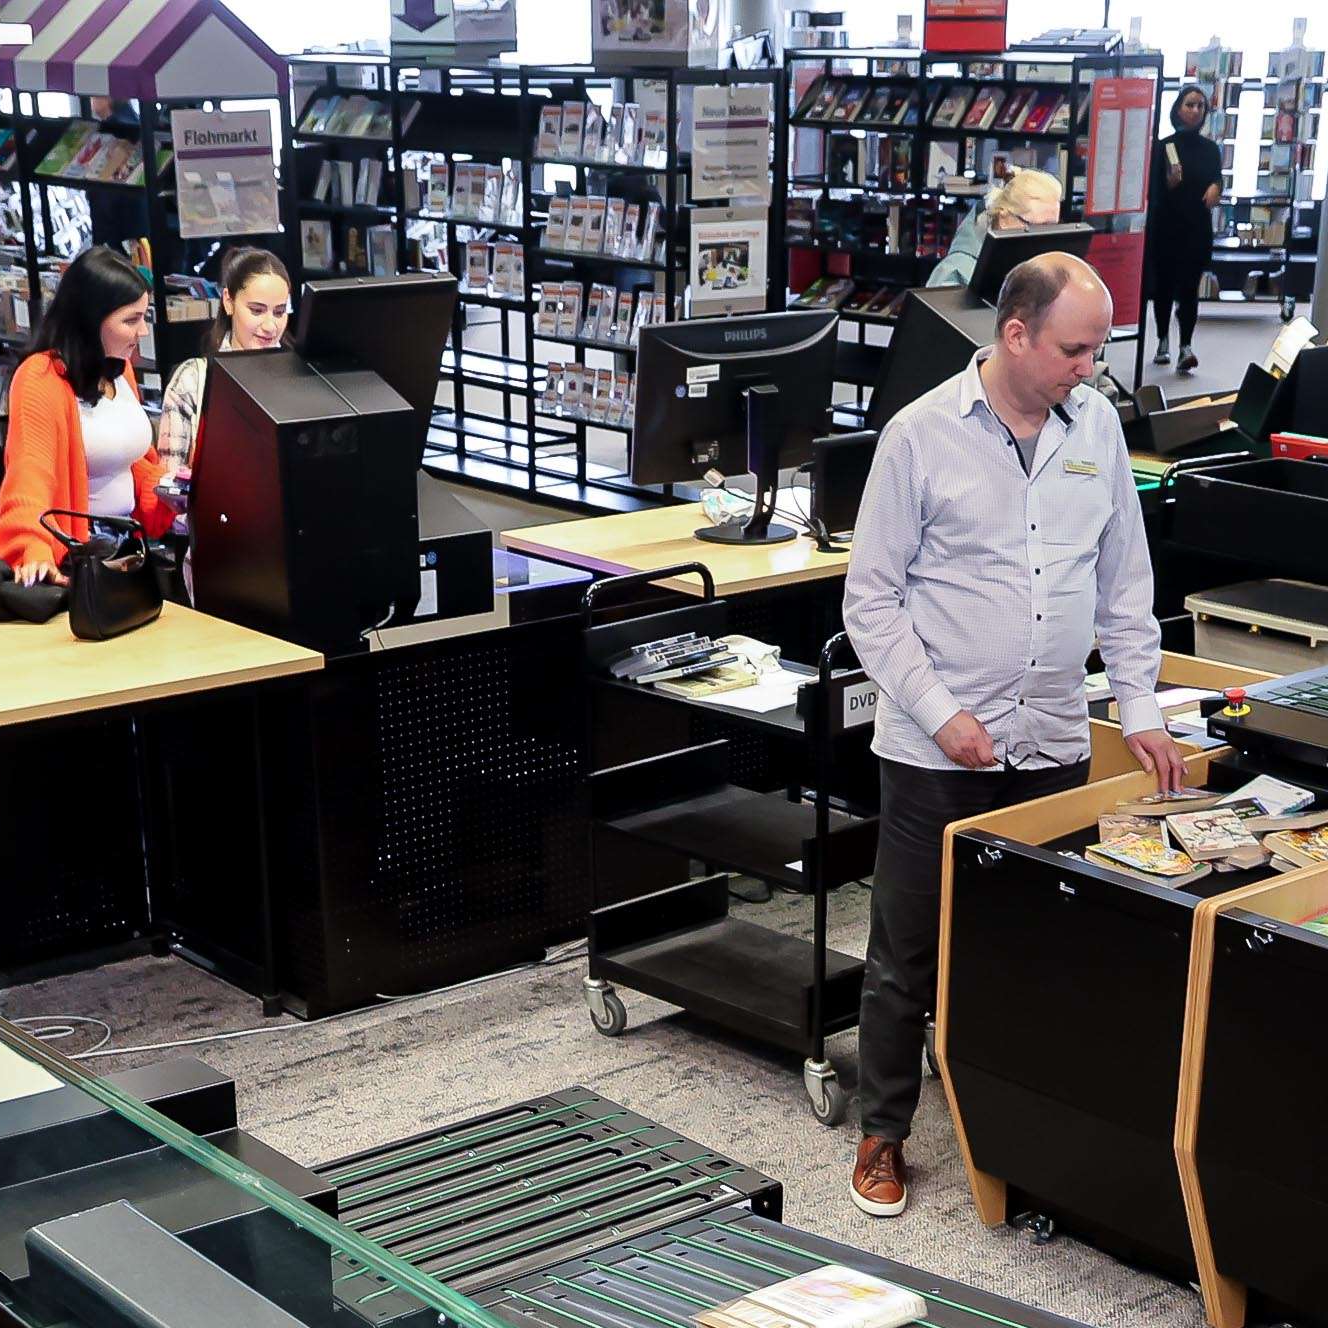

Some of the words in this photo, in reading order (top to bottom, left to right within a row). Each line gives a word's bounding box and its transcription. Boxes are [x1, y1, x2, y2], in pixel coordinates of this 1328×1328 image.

[184, 128, 258, 145] Flohmarkt
[724, 328, 768, 341] PHILIPS
[850, 692, 877, 711] DVD
